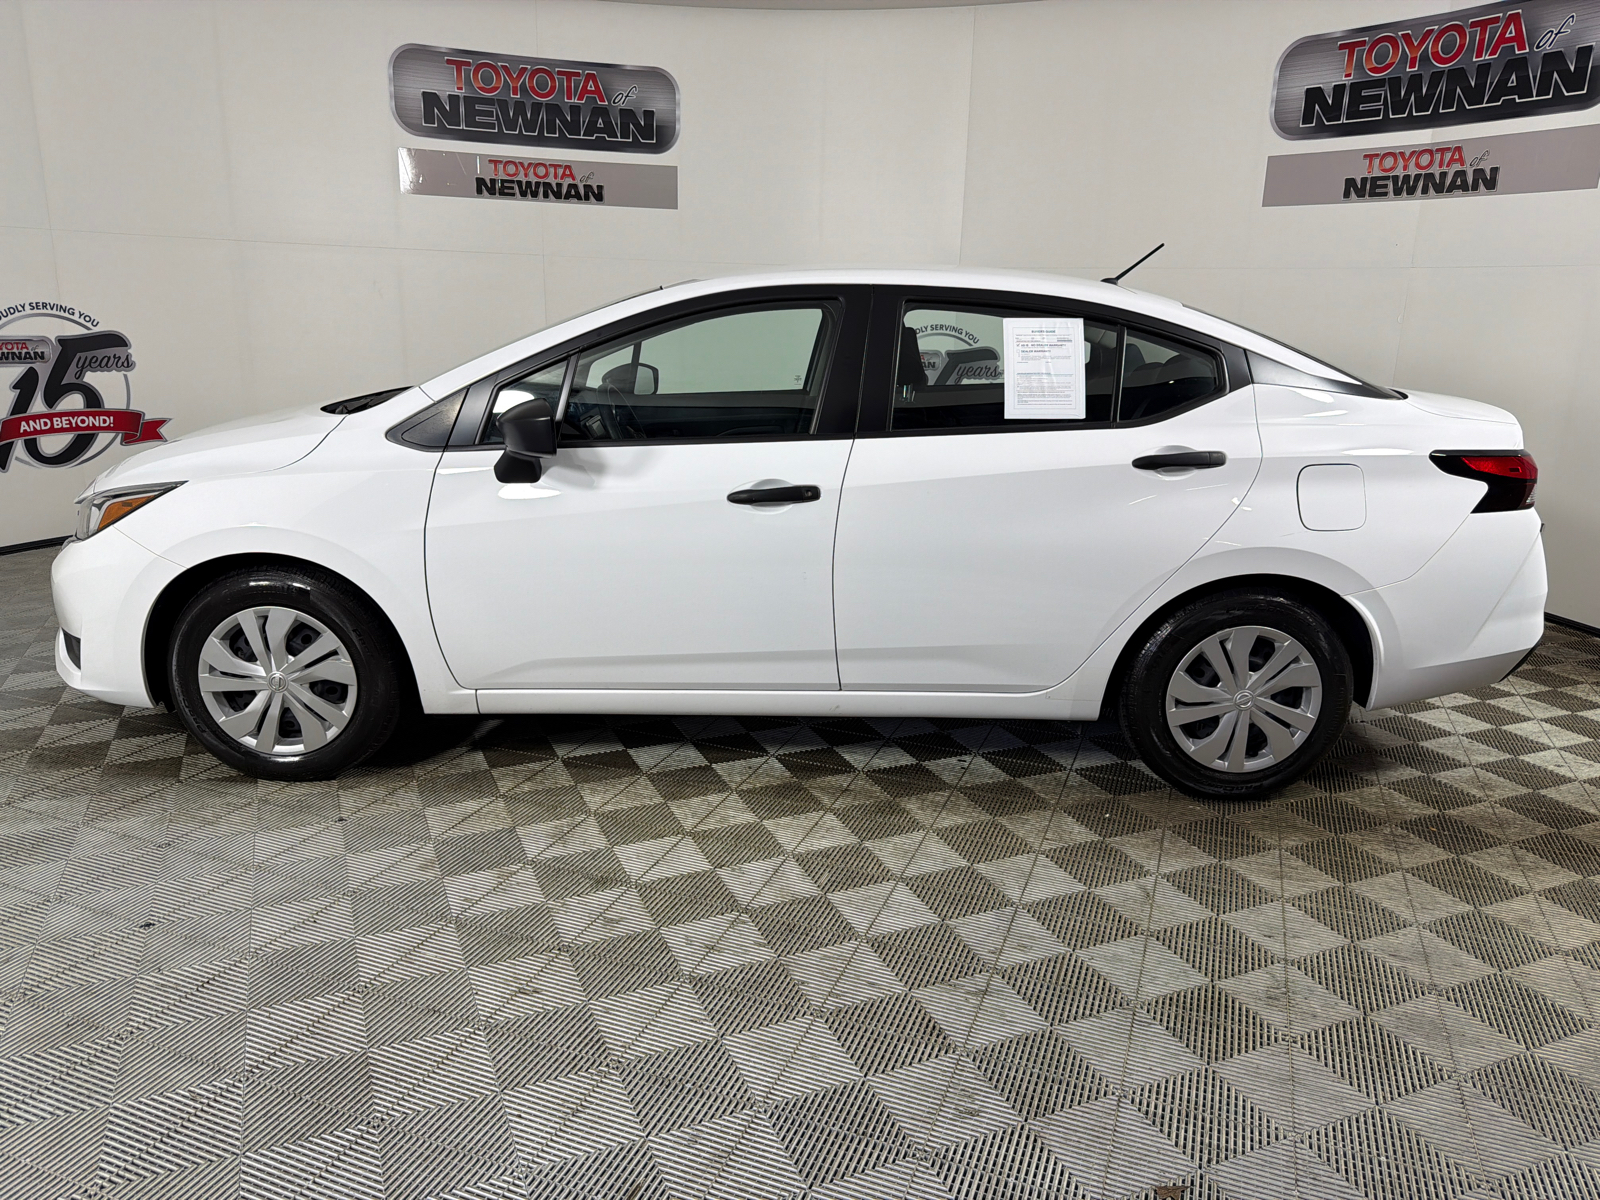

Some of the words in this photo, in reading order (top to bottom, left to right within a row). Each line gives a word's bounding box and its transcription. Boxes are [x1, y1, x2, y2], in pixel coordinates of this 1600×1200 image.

[1338, 10, 1529, 79] TOYOTA
[1534, 13, 1576, 52] of
[445, 57, 608, 104] TOYOTA
[611, 85, 637, 106] of
[1300, 43, 1595, 127] NEWNAN
[421, 90, 657, 143] NEWNAN
[488, 158, 576, 182] TOYOTA
[579, 171, 595, 183] of
[1363, 145, 1466, 175] TOYOTA
[1469, 150, 1490, 168] of
[475, 176, 604, 203] NEWNAN
[1342, 166, 1500, 200] NEWNAN
[28, 302, 76, 316] SERVING
[78, 311, 100, 328] YOU
[930, 324, 964, 336] SERVING
[964, 330, 980, 345] YOU
[74, 353, 134, 381] years
[956, 364, 999, 386] years
[19, 418, 51, 434] AND
[53, 416, 115, 430] BEYOND!
